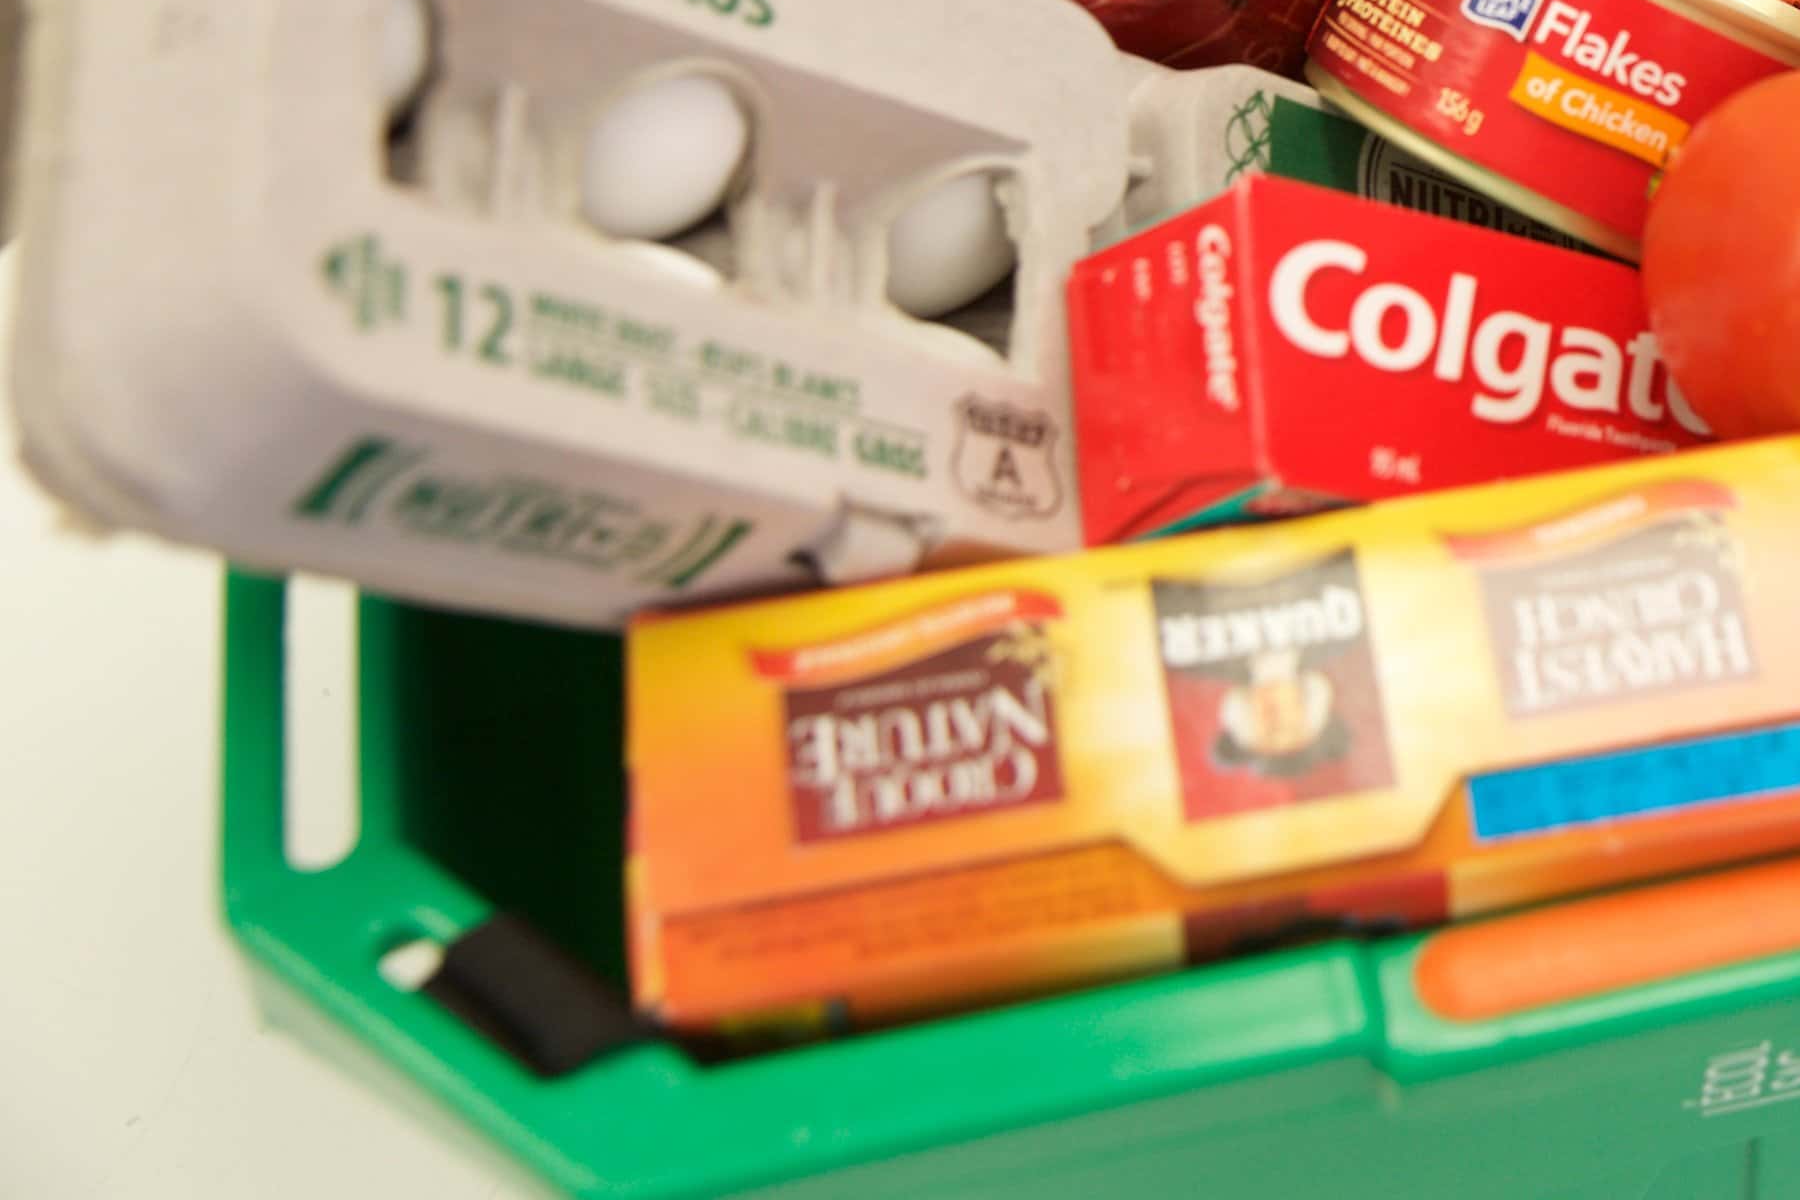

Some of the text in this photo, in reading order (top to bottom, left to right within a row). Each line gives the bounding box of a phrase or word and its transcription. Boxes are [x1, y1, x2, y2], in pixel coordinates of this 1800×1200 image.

[1533, 0, 1688, 107] Flakes
[1525, 76, 1670, 152] of Chicken
[432, 268, 515, 367] 12
[1196, 223, 1241, 413] Colgate
[1158, 583, 1364, 666] QUAKER
[788, 675, 1050, 788] NATURE
